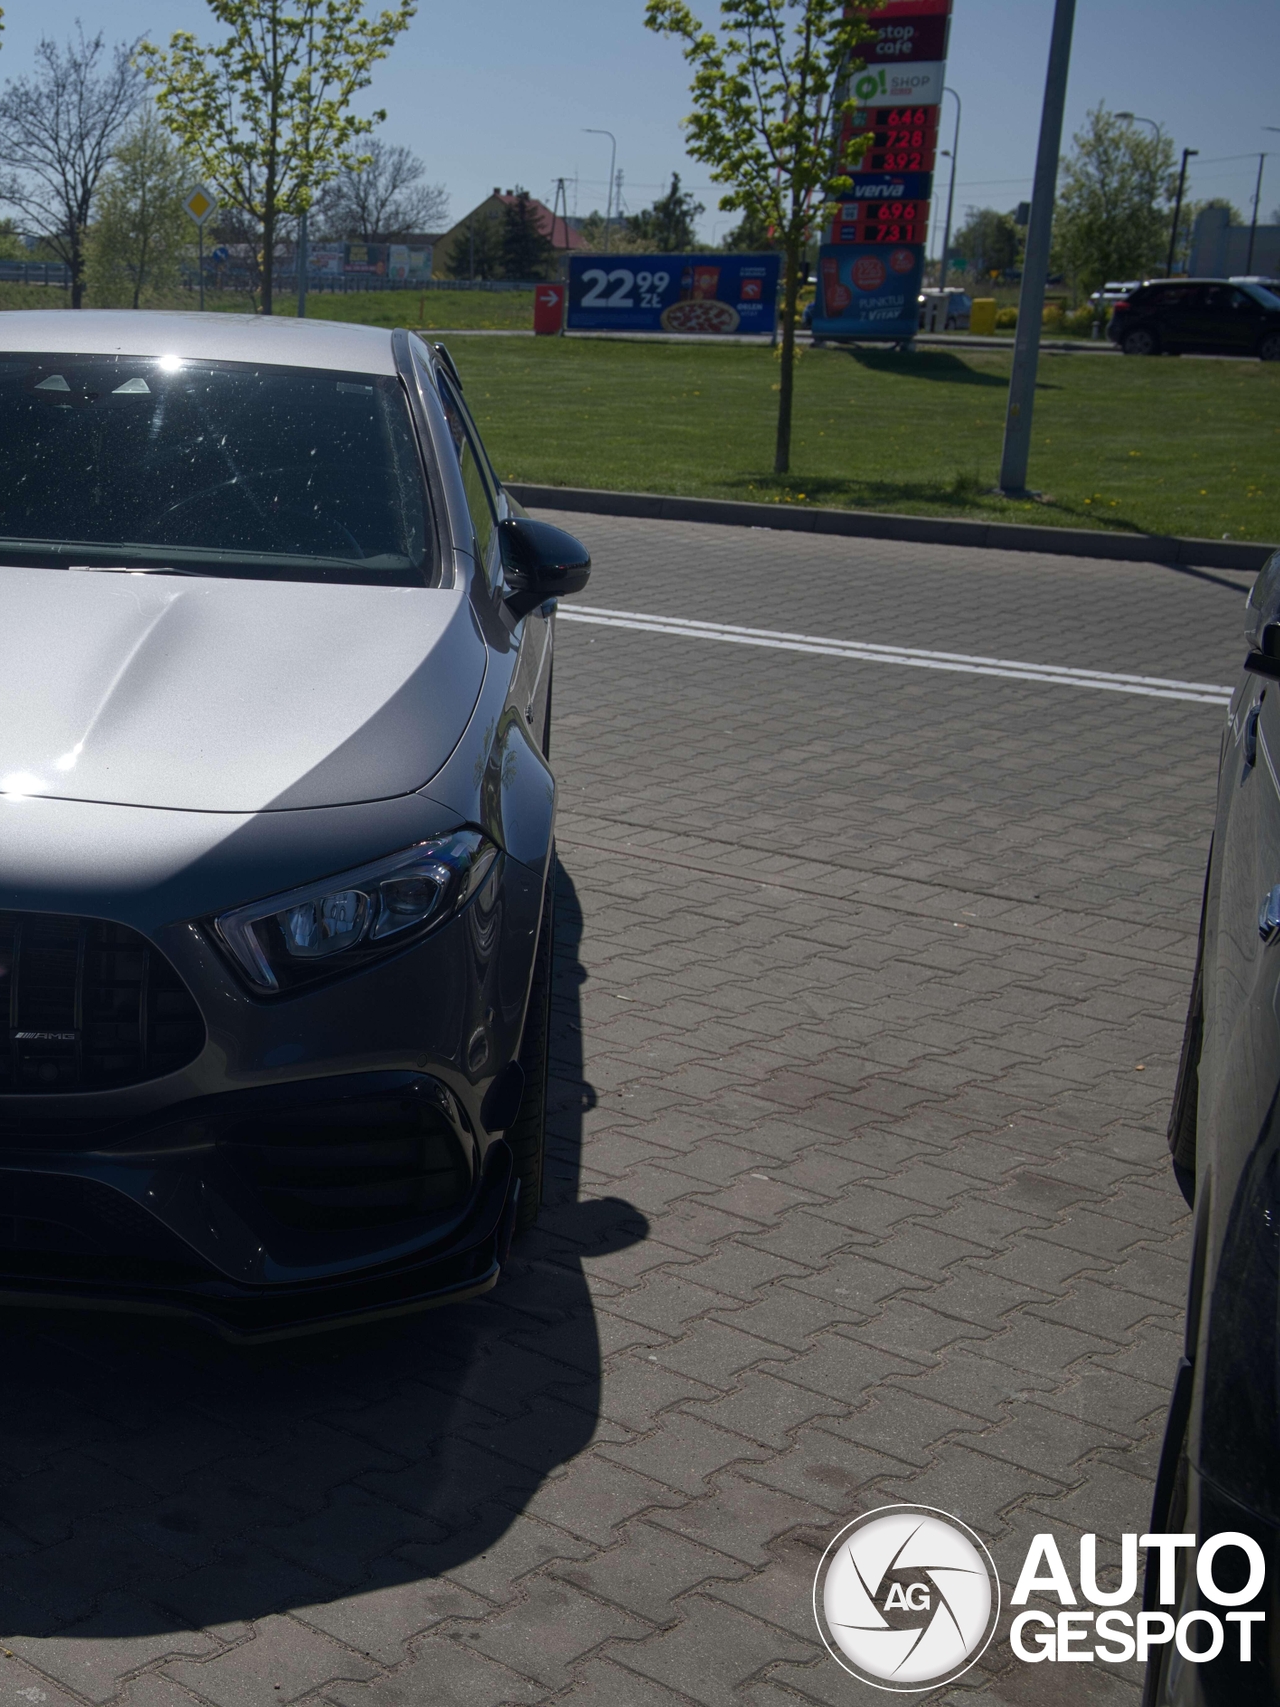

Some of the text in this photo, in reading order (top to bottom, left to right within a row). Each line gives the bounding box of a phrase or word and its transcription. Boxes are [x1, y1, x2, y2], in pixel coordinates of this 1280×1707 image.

[878, 25, 915, 40] stop
[875, 40, 913, 56] cafe
[891, 76, 931, 88] SHOP
[854, 184, 905, 198] verva
[33, 1032, 75, 1040] AMG
